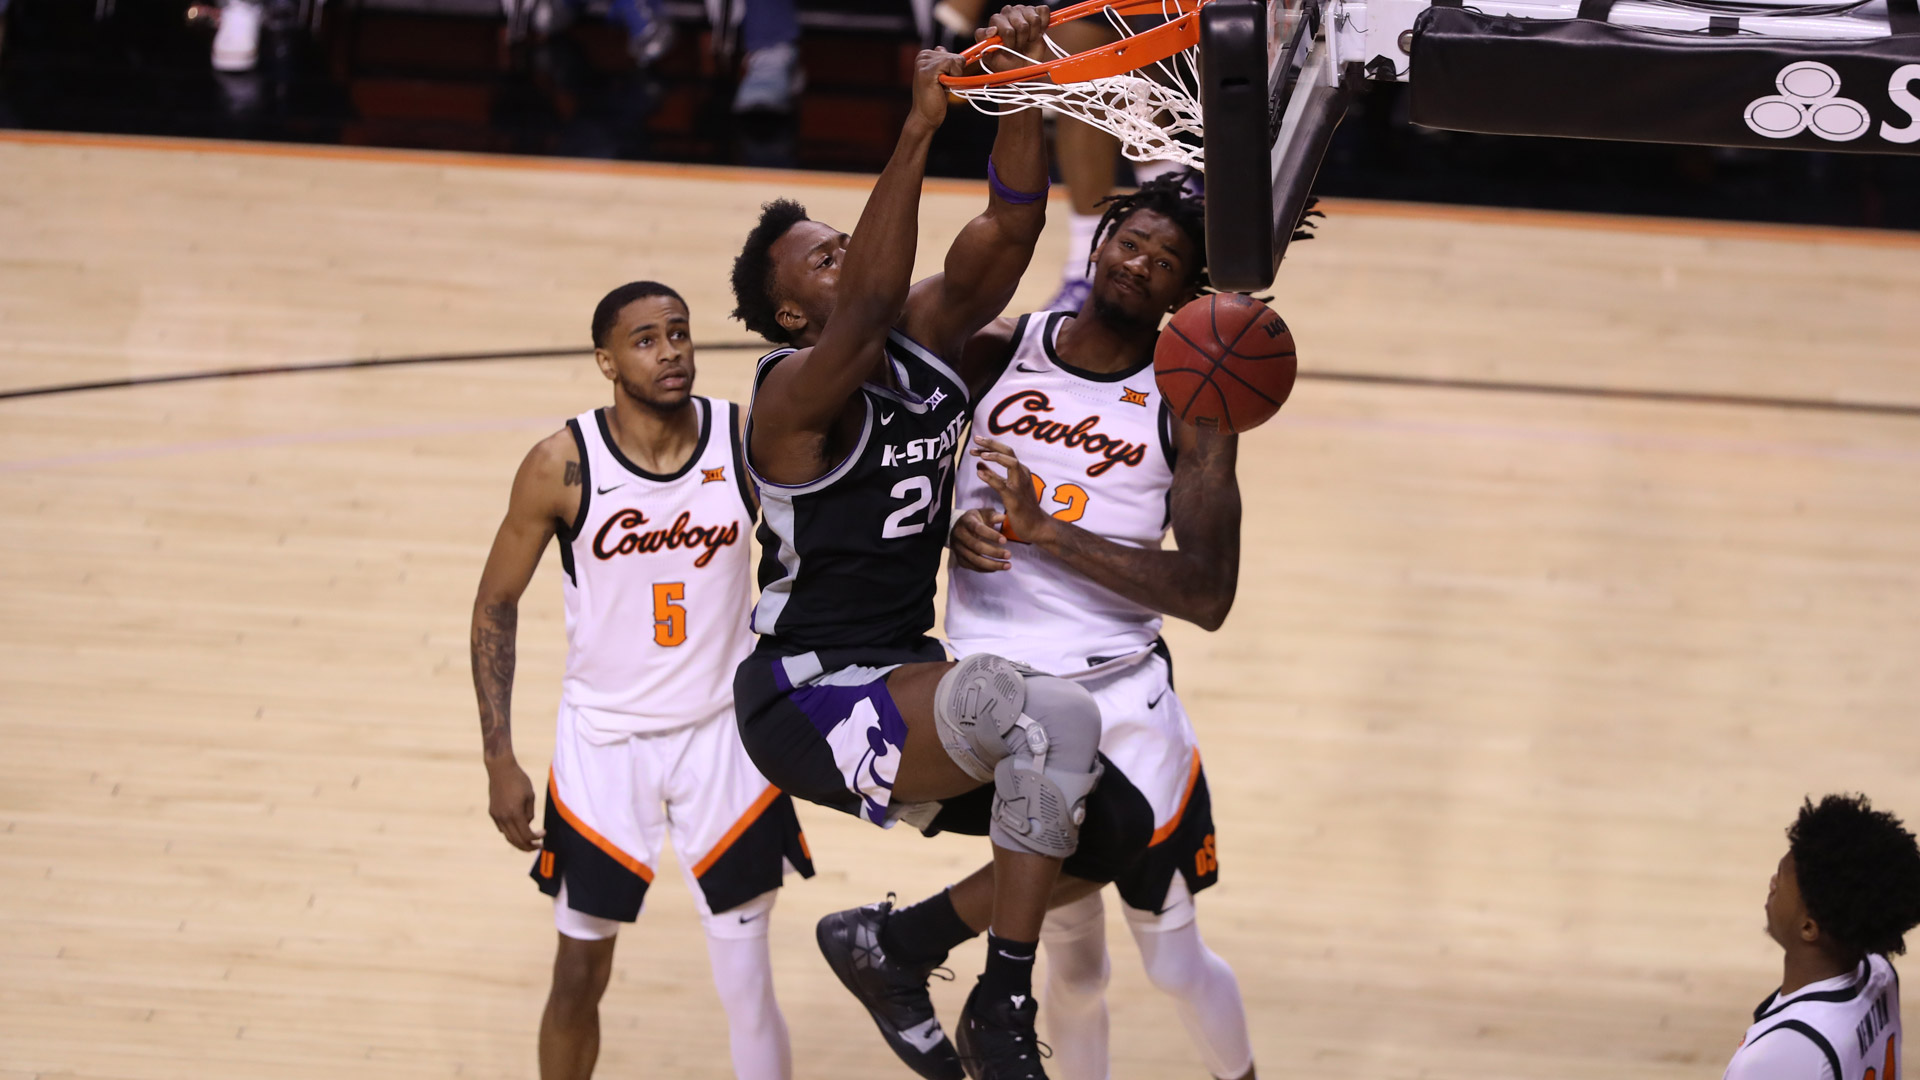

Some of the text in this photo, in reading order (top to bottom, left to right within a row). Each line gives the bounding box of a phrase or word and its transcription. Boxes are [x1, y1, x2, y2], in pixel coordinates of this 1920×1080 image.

[925, 387, 948, 411] XII
[1119, 386, 1149, 407] XII
[881, 410, 965, 467] K-STATE
[988, 390, 1148, 478] Cowboys
[701, 466, 726, 485] XII
[592, 508, 738, 568] Cowboys
[652, 582, 687, 647] 5
